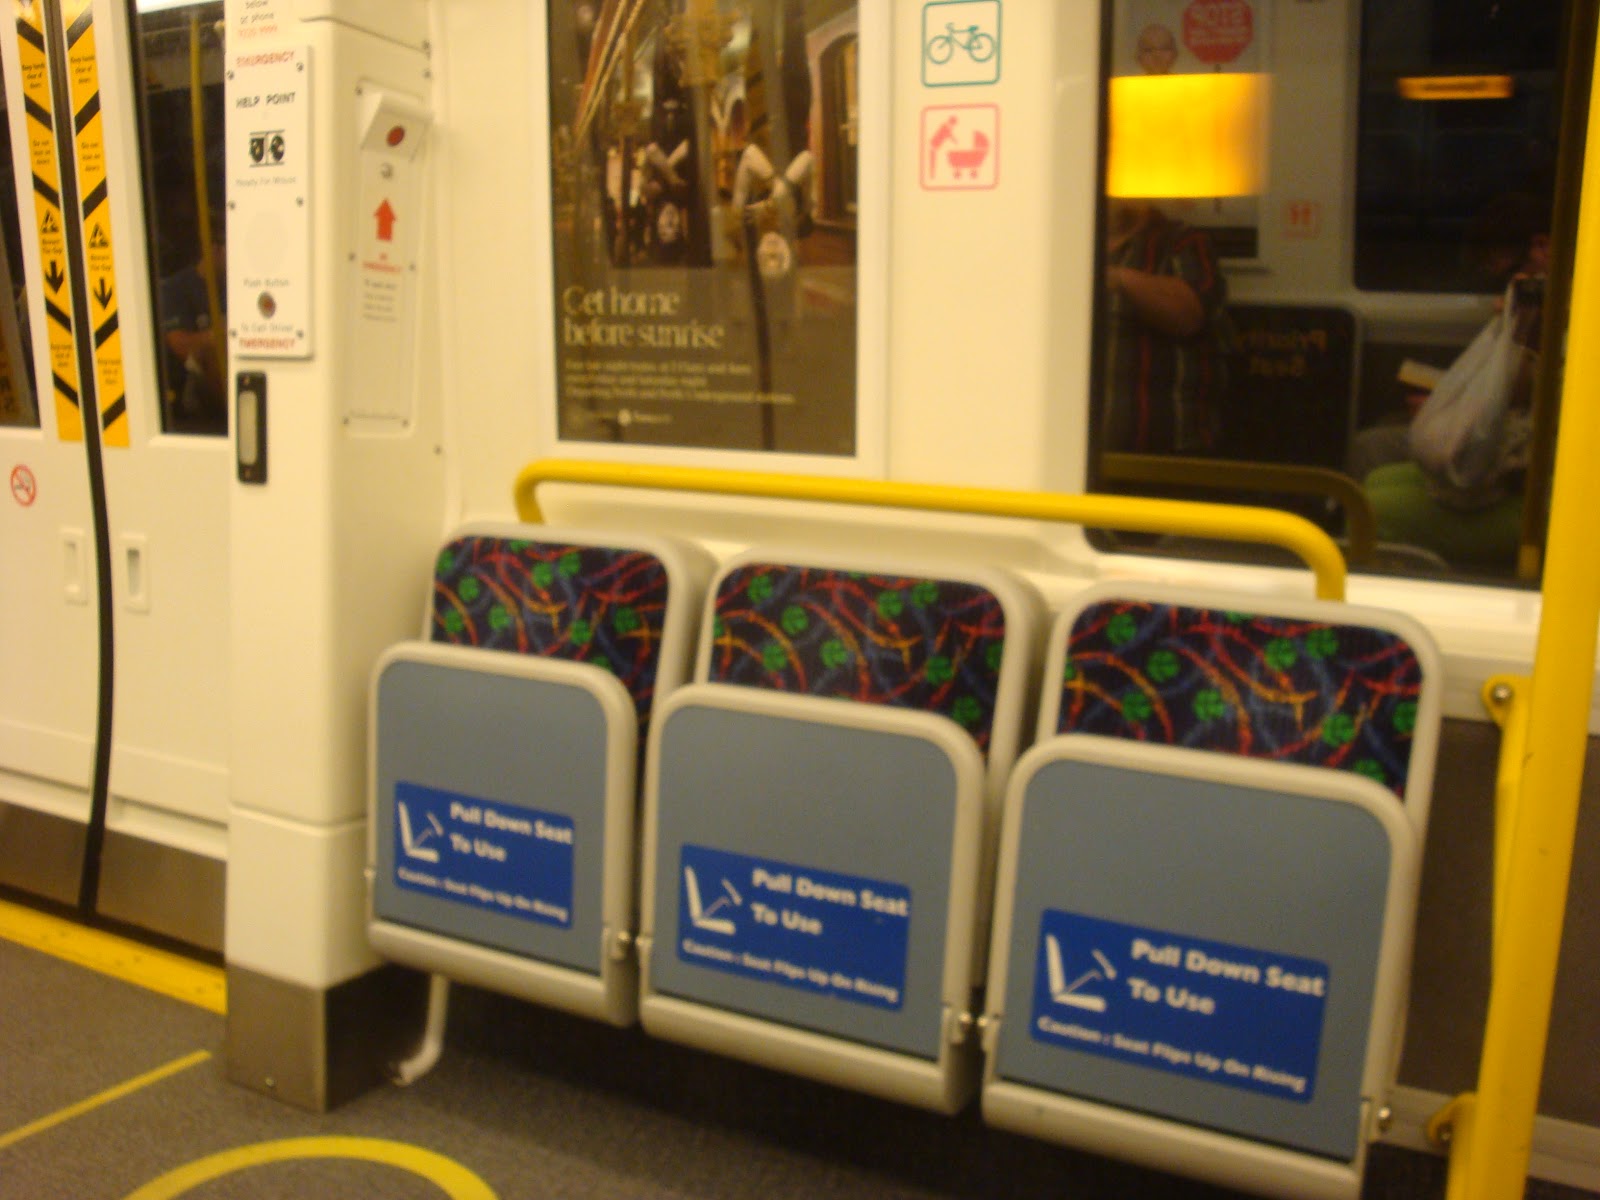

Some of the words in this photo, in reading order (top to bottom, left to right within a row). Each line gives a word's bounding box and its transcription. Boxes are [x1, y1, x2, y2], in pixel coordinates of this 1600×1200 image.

[236, 51, 295, 67] EMERGENCY
[236, 95, 260, 109] HELP
[266, 91, 296, 105] POINT
[562, 285, 604, 315] Get
[610, 285, 680, 315] home
[239, 338, 295, 349] EMERGENCY
[564, 317, 635, 346] before
[637, 319, 725, 348] sunrise
[450, 802, 482, 824] Pull
[484, 809, 533, 836] Down
[534, 819, 572, 844] Seat
[450, 832, 472, 854] To
[474, 837, 507, 862] Use
[752, 868, 792, 894] Pull
[796, 876, 856, 906] Down
[860, 889, 908, 917] Seat
[751, 902, 778, 926] To
[781, 908, 822, 936] Use
[1131, 938, 1182, 968] Pull
[1185, 950, 1260, 984] Down
[1264, 965, 1326, 998] Seat
[1126, 976, 1161, 1004] To
[1165, 985, 1216, 1015] Use
[1112, 1033, 1149, 1055] Seat
[1151, 1042, 1192, 1066] Flips
[1194, 1051, 1221, 1073] Up
[1223, 1058, 1250, 1078] On
[1252, 1063, 1306, 1094] Rising
